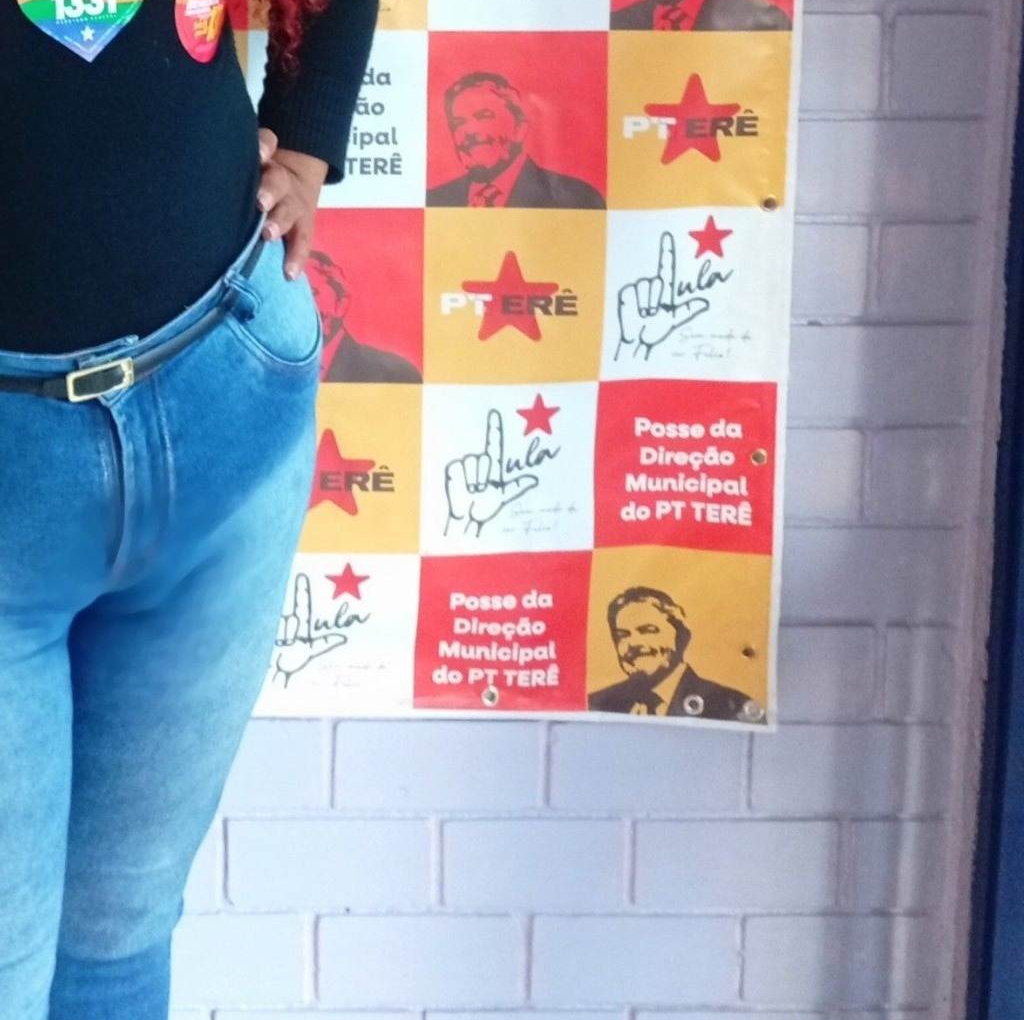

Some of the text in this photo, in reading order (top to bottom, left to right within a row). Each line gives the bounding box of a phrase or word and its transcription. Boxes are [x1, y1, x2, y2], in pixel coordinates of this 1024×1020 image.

[345, 153, 402, 175] TERÊ
[634, 417, 743, 439] Posse da
[639, 445, 735, 471] Direção
[625, 472, 749, 498] Municipal
[619, 500, 753, 527] do PT TERÊ
[449, 589, 554, 611] Posse da
[453, 617, 547, 641] Direção
[438, 640, 557, 666] Municipal
[431, 663, 560, 688] do PT TERÊ
